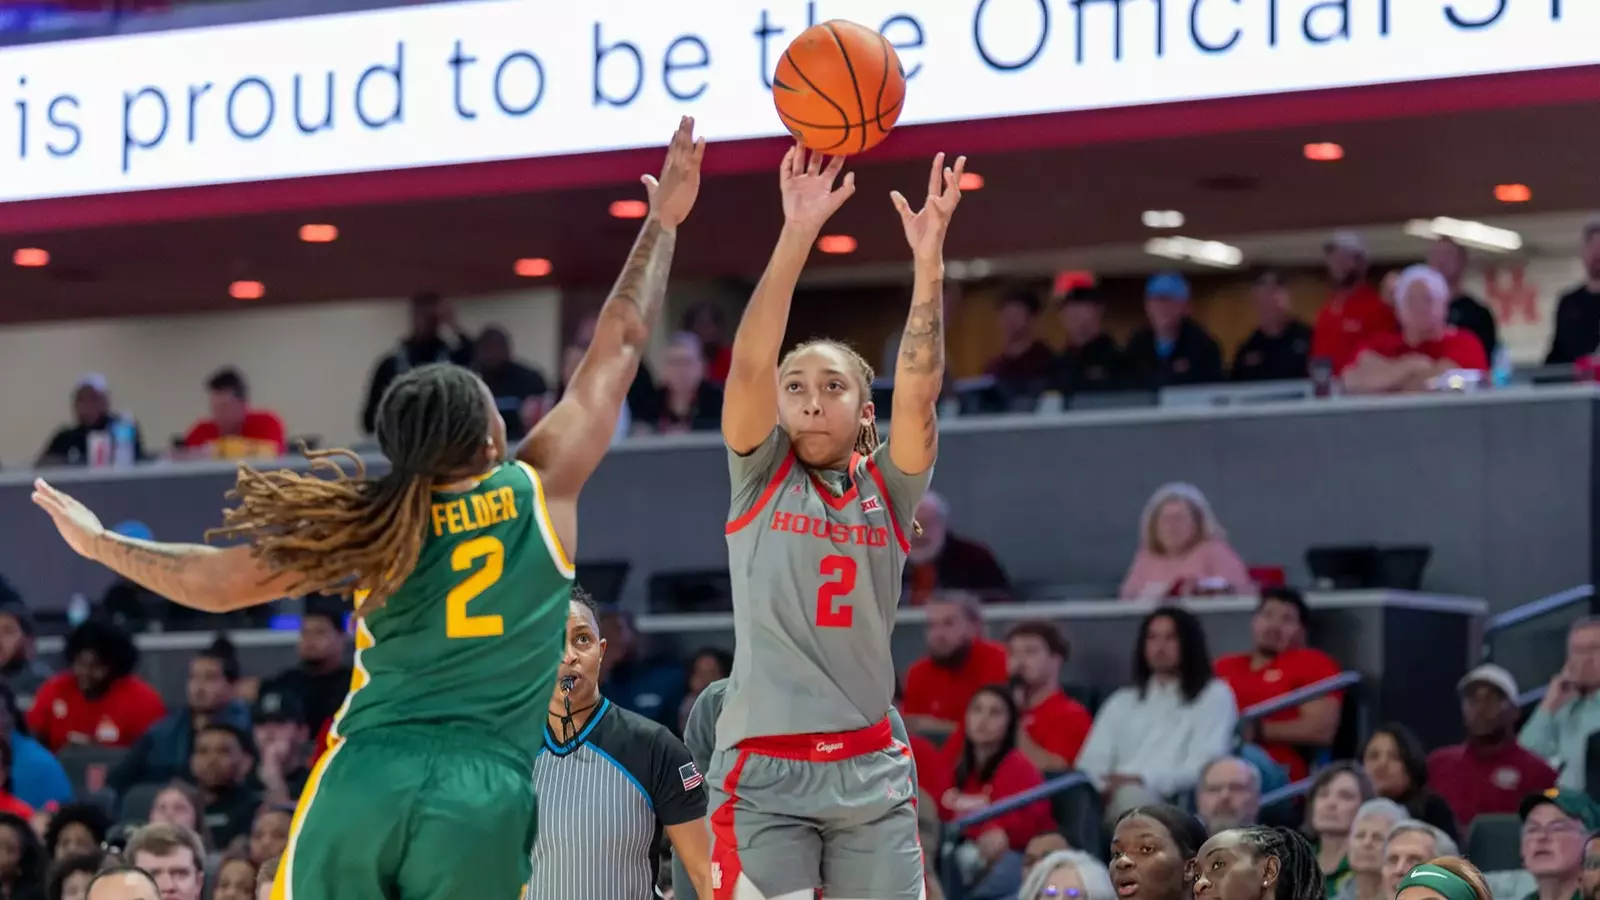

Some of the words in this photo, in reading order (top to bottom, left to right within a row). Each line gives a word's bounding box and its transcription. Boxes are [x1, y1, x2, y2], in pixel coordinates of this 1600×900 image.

[15, 77, 82, 158] is
[121, 40, 405, 173] proud
[447, 39, 546, 119] to
[592, 21, 711, 107] be
[752, 2, 925, 90] te
[431, 486, 518, 536] FELDER
[446, 535, 504, 638] 2
[816, 554, 857, 628] 2
